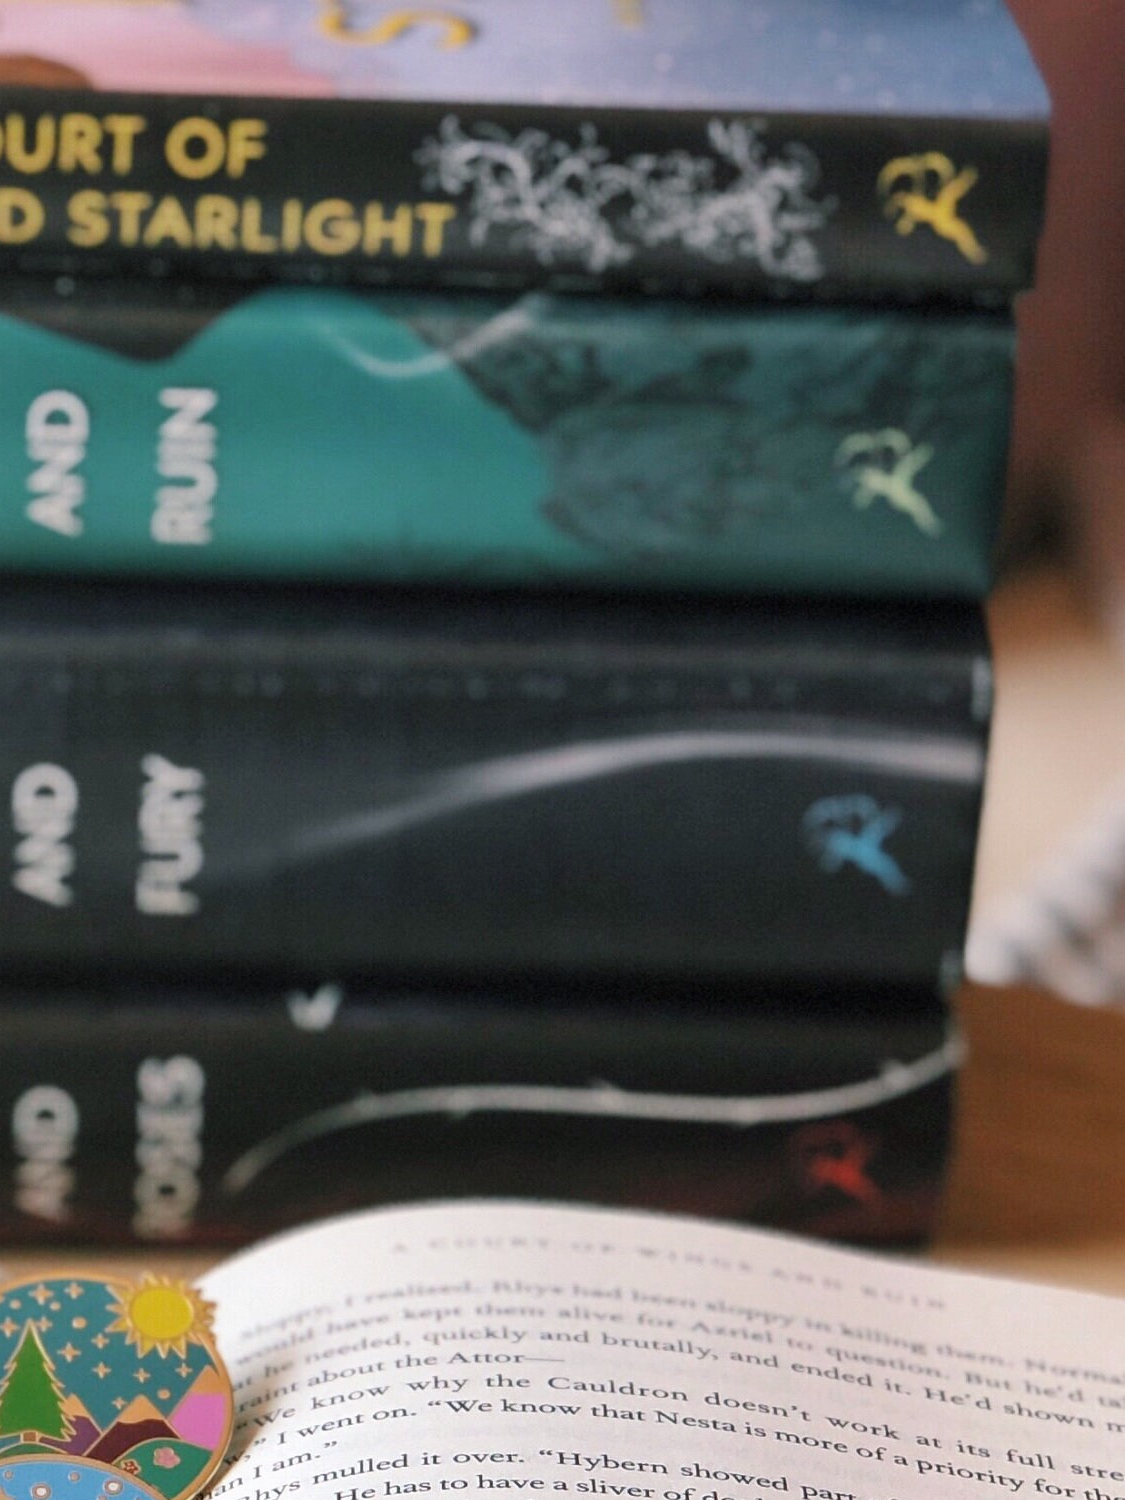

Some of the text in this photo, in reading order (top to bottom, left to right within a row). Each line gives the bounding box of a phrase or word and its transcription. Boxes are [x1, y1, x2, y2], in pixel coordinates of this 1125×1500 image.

[164, 116, 266, 179] OF
[68, 191, 455, 256] STARLIGHT
[26, 390, 89, 536] AND
[151, 388, 217, 544] RUIN
[12, 763, 78, 906] AND
